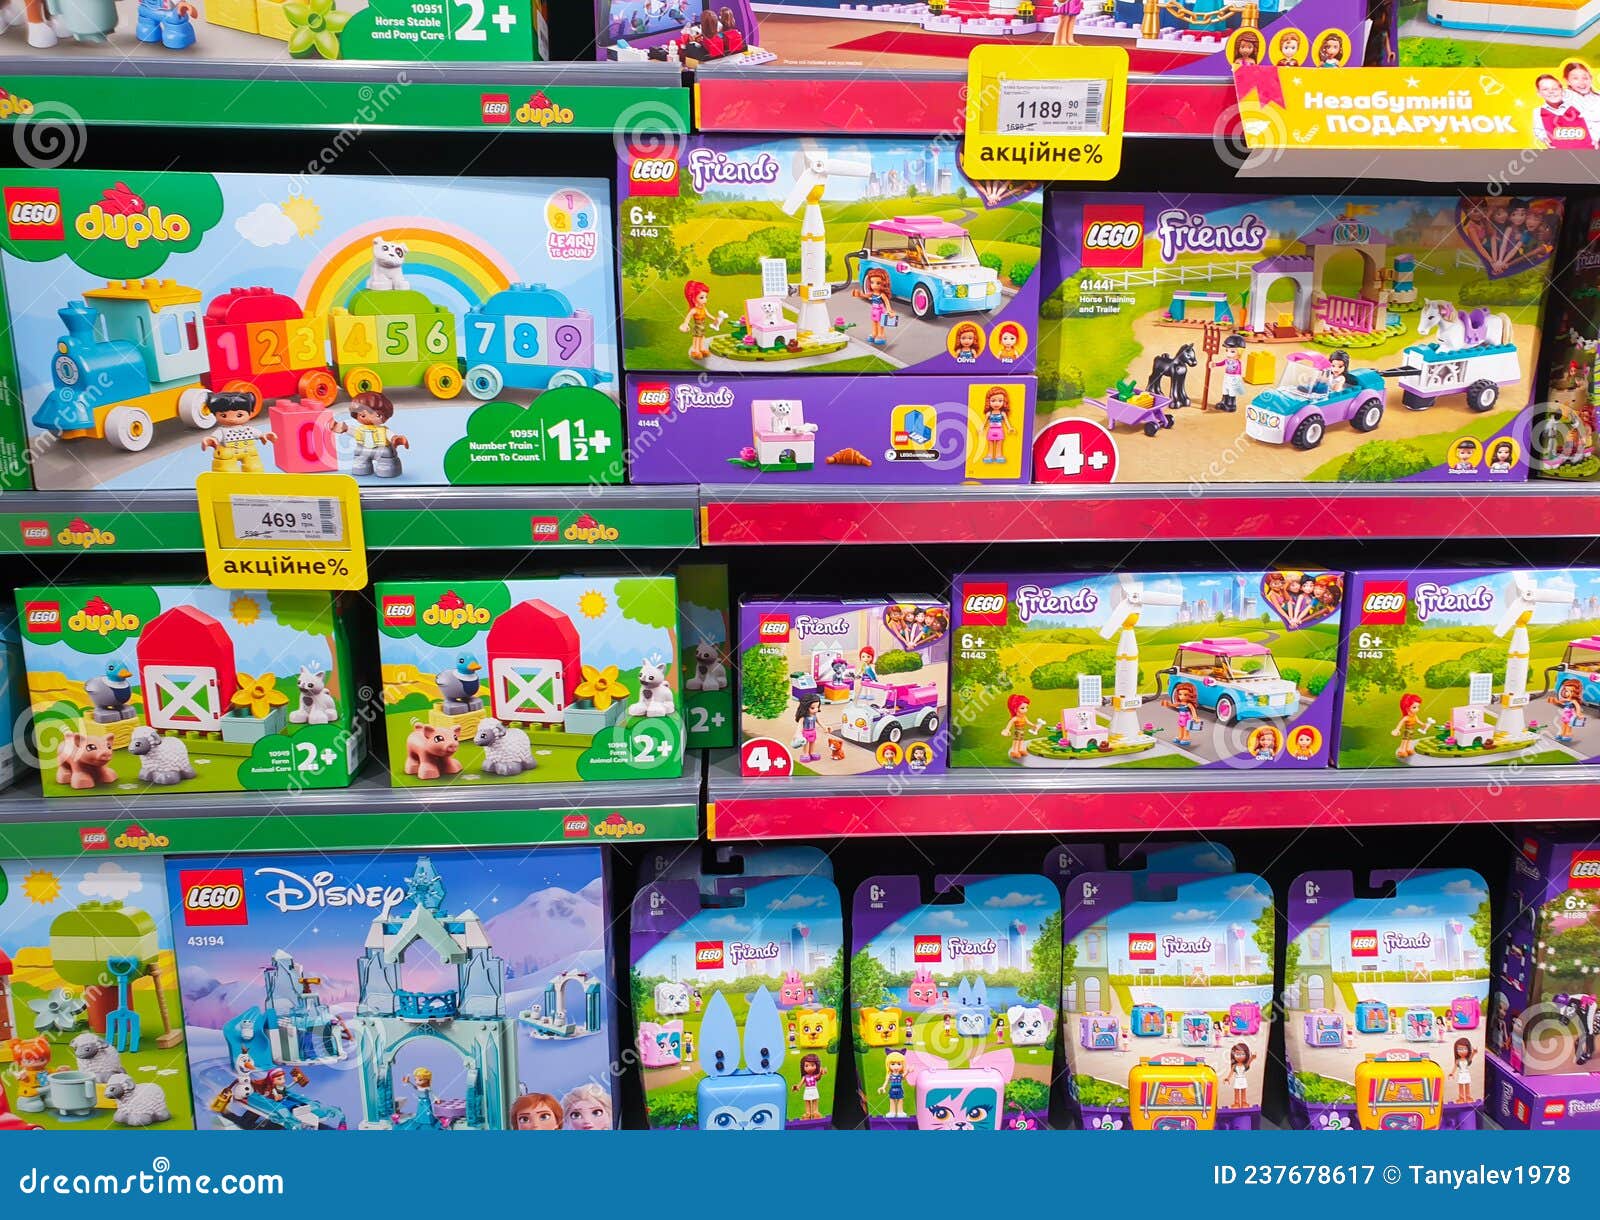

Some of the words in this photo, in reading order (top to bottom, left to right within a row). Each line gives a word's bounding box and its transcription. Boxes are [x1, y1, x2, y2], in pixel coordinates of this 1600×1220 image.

[411, 4, 443, 14] 10951
[375, 16, 405, 27] Horse
[407, 16, 441, 27] Stable
[371, 30, 392, 40] and
[393, 31, 419, 42] Pony
[420, 31, 445, 41] Care
[1017, 101, 1062, 119] 1189
[1068, 100, 1079, 109] 90
[1304, 90, 1473, 115] Незабутній
[484, 102, 509, 115] LEGO
[516, 103, 574, 128] duplo
[1326, 115, 1518, 136] ПОДАРУНОК
[1554, 127, 1585, 140] LEGO
[980, 142, 1103, 165] акційне%
[631, 158, 677, 182] LEGO
[629, 206, 656, 225] 6+
[10, 202, 60, 226] LEGO
[75, 204, 191, 248] duplo
[630, 228, 658, 238] 41443
[549, 232, 596, 248] LEARN
[1086, 220, 1142, 250] LEGO
[1079, 280, 1114, 290] 41441
[1079, 296, 1103, 304] Horse
[1104, 296, 1136, 305] Training
[1095, 306, 1121, 314] Trailer
[638, 390, 669, 406] LEGO
[509, 430, 539, 438] 10954
[469, 442, 507, 450] Number
[508, 442, 533, 450] Train
[1044, 433, 1108, 476] 4+
[470, 454, 498, 462] Learn
[499, 454, 511, 462] To
[512, 454, 540, 462] Count
[261, 512, 296, 528] 469
[25, 528, 48, 538] LEGO
[57, 528, 116, 548] duplo
[535, 523, 557, 534] LEGO
[564, 524, 620, 544] duplo
[223, 556, 349, 576] акційне%
[964, 594, 1006, 614] LEGO
[1363, 592, 1406, 612] LEGO
[28, 610, 59, 624] LEGO
[68, 610, 140, 636] duplo
[386, 604, 415, 618] LEGO
[422, 603, 491, 630] duplo
[760, 621, 788, 636] LEGO
[961, 634, 985, 650] 6+
[1358, 632, 1383, 649] 6+
[960, 652, 986, 660] 41443
[1357, 651, 1383, 659] 41443
[690, 707, 726, 733] 2+
[296, 742, 338, 771] 2+
[634, 734, 672, 763] 2+
[746, 746, 787, 772] 4+
[566, 820, 587, 830] LEGO
[594, 820, 646, 838] duplo
[84, 832, 106, 843] LEGO
[114, 832, 170, 851] duplo
[1059, 853, 1074, 869] 6+
[870, 884, 886, 902] 6+
[1082, 882, 1099, 898] 6+
[1306, 880, 1320, 897] 6+
[186, 885, 244, 910] LEGO
[650, 892, 667, 909] 6+
[1564, 896, 1587, 910] 6+
[187, 936, 224, 946] 43194
[916, 942, 942, 954] LEGO
[1130, 940, 1155, 955] LEGO
[1352, 936, 1378, 950] LEGO
[696, 948, 722, 964] LEGO
